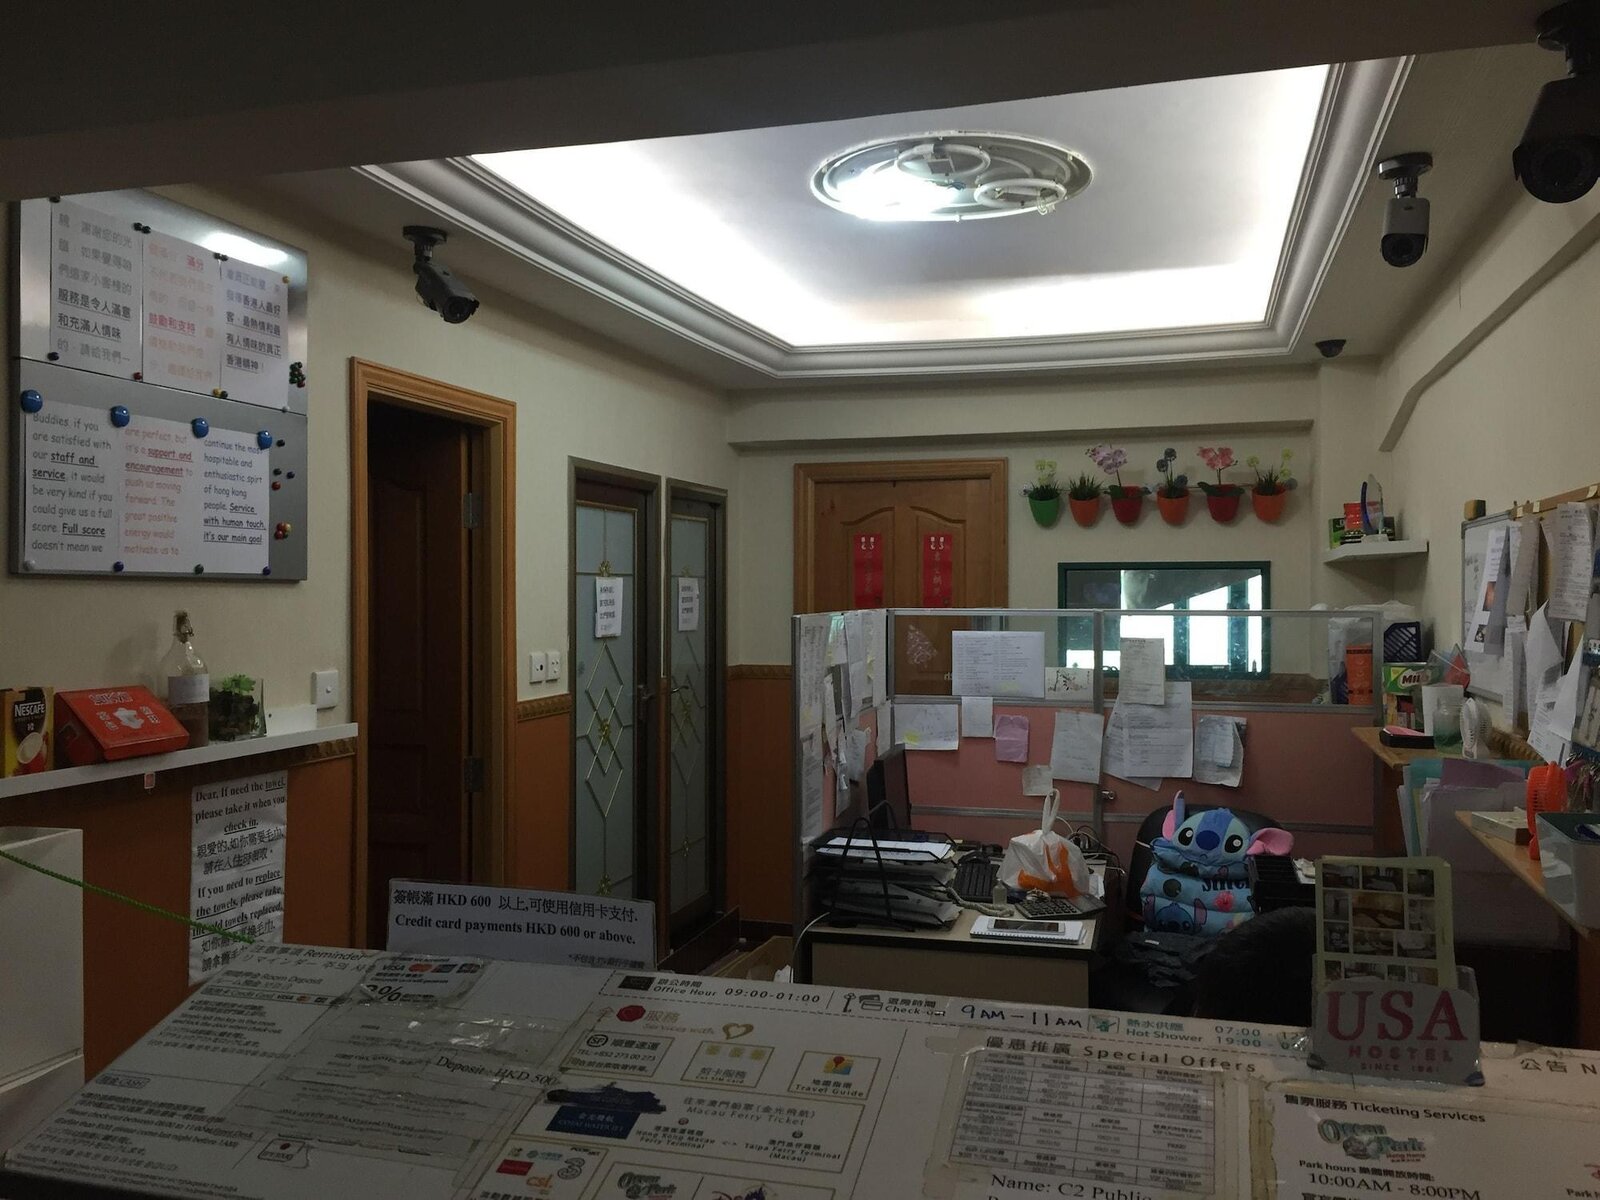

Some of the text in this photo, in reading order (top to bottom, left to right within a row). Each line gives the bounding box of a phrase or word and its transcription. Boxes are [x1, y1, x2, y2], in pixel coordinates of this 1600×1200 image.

[58, 287, 131, 319] 服務是令人滿意
[57, 312, 121, 339] 和充滿人情味
[226, 332, 281, 356] 有人情味的真正
[84, 422, 99, 432] you
[32, 432, 112, 450] are satisfied with
[204, 439, 232, 451] continue
[32, 451, 95, 465] our staff and
[204, 453, 252, 469] hospitable and
[125, 462, 183, 475] encouragement
[80, 474, 105, 484] would
[204, 470, 245, 483] enthusiastic
[45, 487, 66, 500] very
[68, 487, 87, 499] kind
[97, 491, 112, 504] you
[213, 485, 229, 497] hong
[32, 504, 56, 515] could
[58, 506, 76, 519] give
[97, 506, 112, 519] full
[230, 503, 255, 513] Service
[62, 522, 105, 536] Full score
[204, 516, 243, 527] with human
[231, 534, 247, 542] main
[32, 540, 64, 552] doesn't
[66, 544, 89, 553] mean
[230, 783, 250, 795] need
[251, 781, 264, 791] the
[195, 808, 222, 823] please
[225, 801, 244, 814] take
[252, 798, 272, 811] when
[272, 796, 285, 809] you
[224, 820, 247, 833] check
[207, 884, 224, 899] you
[226, 878, 243, 891] need
[255, 869, 281, 885] replace
[196, 891, 263, 918] the please
[437, 893, 467, 906] HKD
[470, 895, 491, 908] 600
[225, 914, 248, 928] towels
[395, 914, 636, 945] Credit card payments HKD 600 or above.
[303, 949, 365, 961] Reminder
[653, 986, 820, 1003] Office Hour 09:00-01:00
[1325, 990, 1468, 1042] USA
[1126, 1028, 1203, 1043] Hot Shower
[1214, 1026, 1261, 1037] 07:00
[1217, 1036, 1262, 1048] 19:00
[986, 1036, 1256, 1073] 優惠推廣 Special Offers
[1348, 1045, 1453, 1062] HOSTEL
[436, 1056, 484, 1075] Deposit
[1360, 1062, 1400, 1071] SINCE
[1520, 1058, 1568, 1073] 公告
[795, 1084, 865, 1098] Travel Guide
[686, 1106, 805, 1127] Macau Ferry Ticket
[1351, 1101, 1419, 1119] Ticketing
[1423, 1109, 1486, 1123] Services
[744, 1143, 769, 1152] Taipa
[1299, 1160, 1356, 1173] Park hours
[991, 1173, 1051, 1194] Name:
[1058, 1182, 1084, 1198] C2
[1308, 1172, 1482, 1200] 10:00AM 8:00PM
